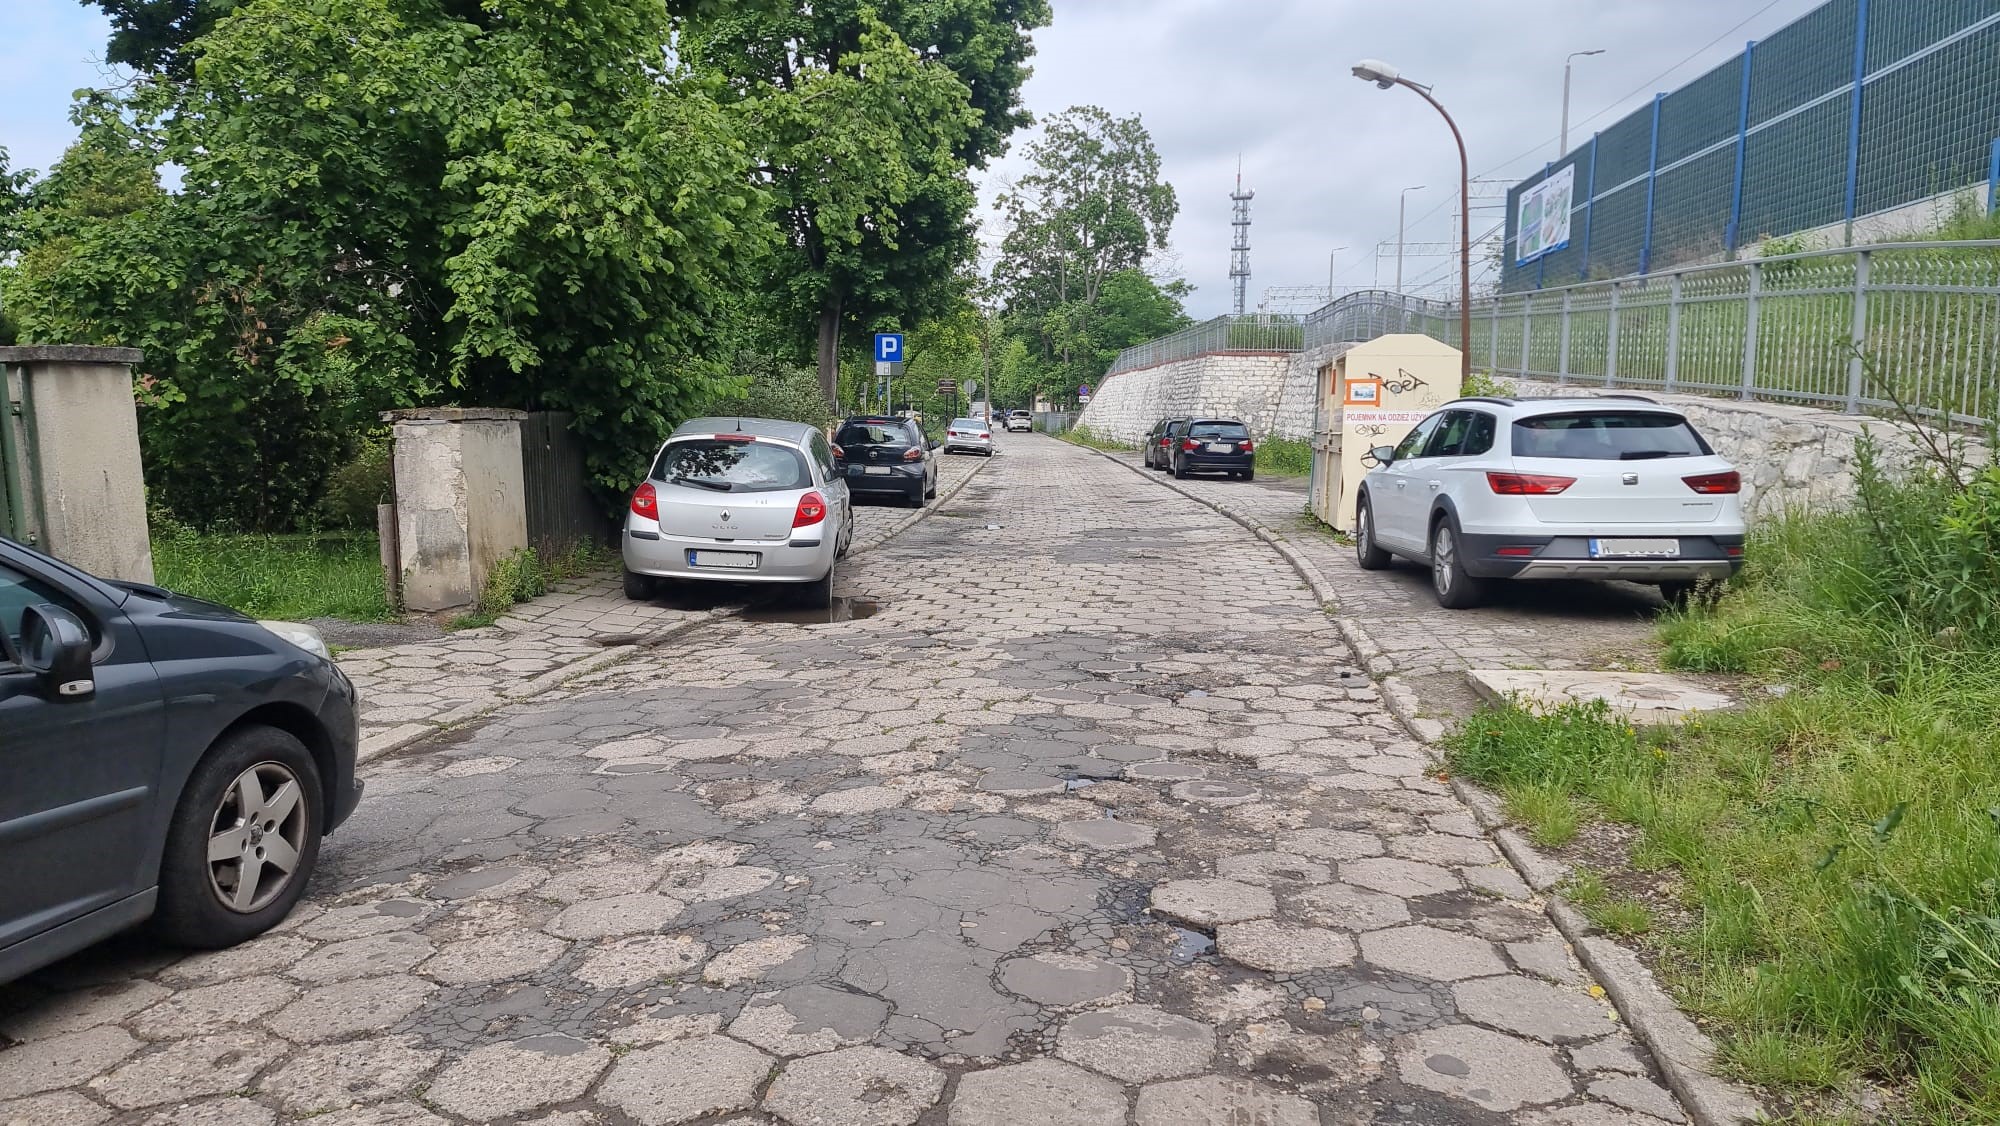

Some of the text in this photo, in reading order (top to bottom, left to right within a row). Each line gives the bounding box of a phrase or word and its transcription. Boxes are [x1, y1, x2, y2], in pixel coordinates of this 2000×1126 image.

[882, 337, 897, 358] P
[1346, 413, 1377, 421] POJEMNIK
[1378, 413, 1386, 421] NA
